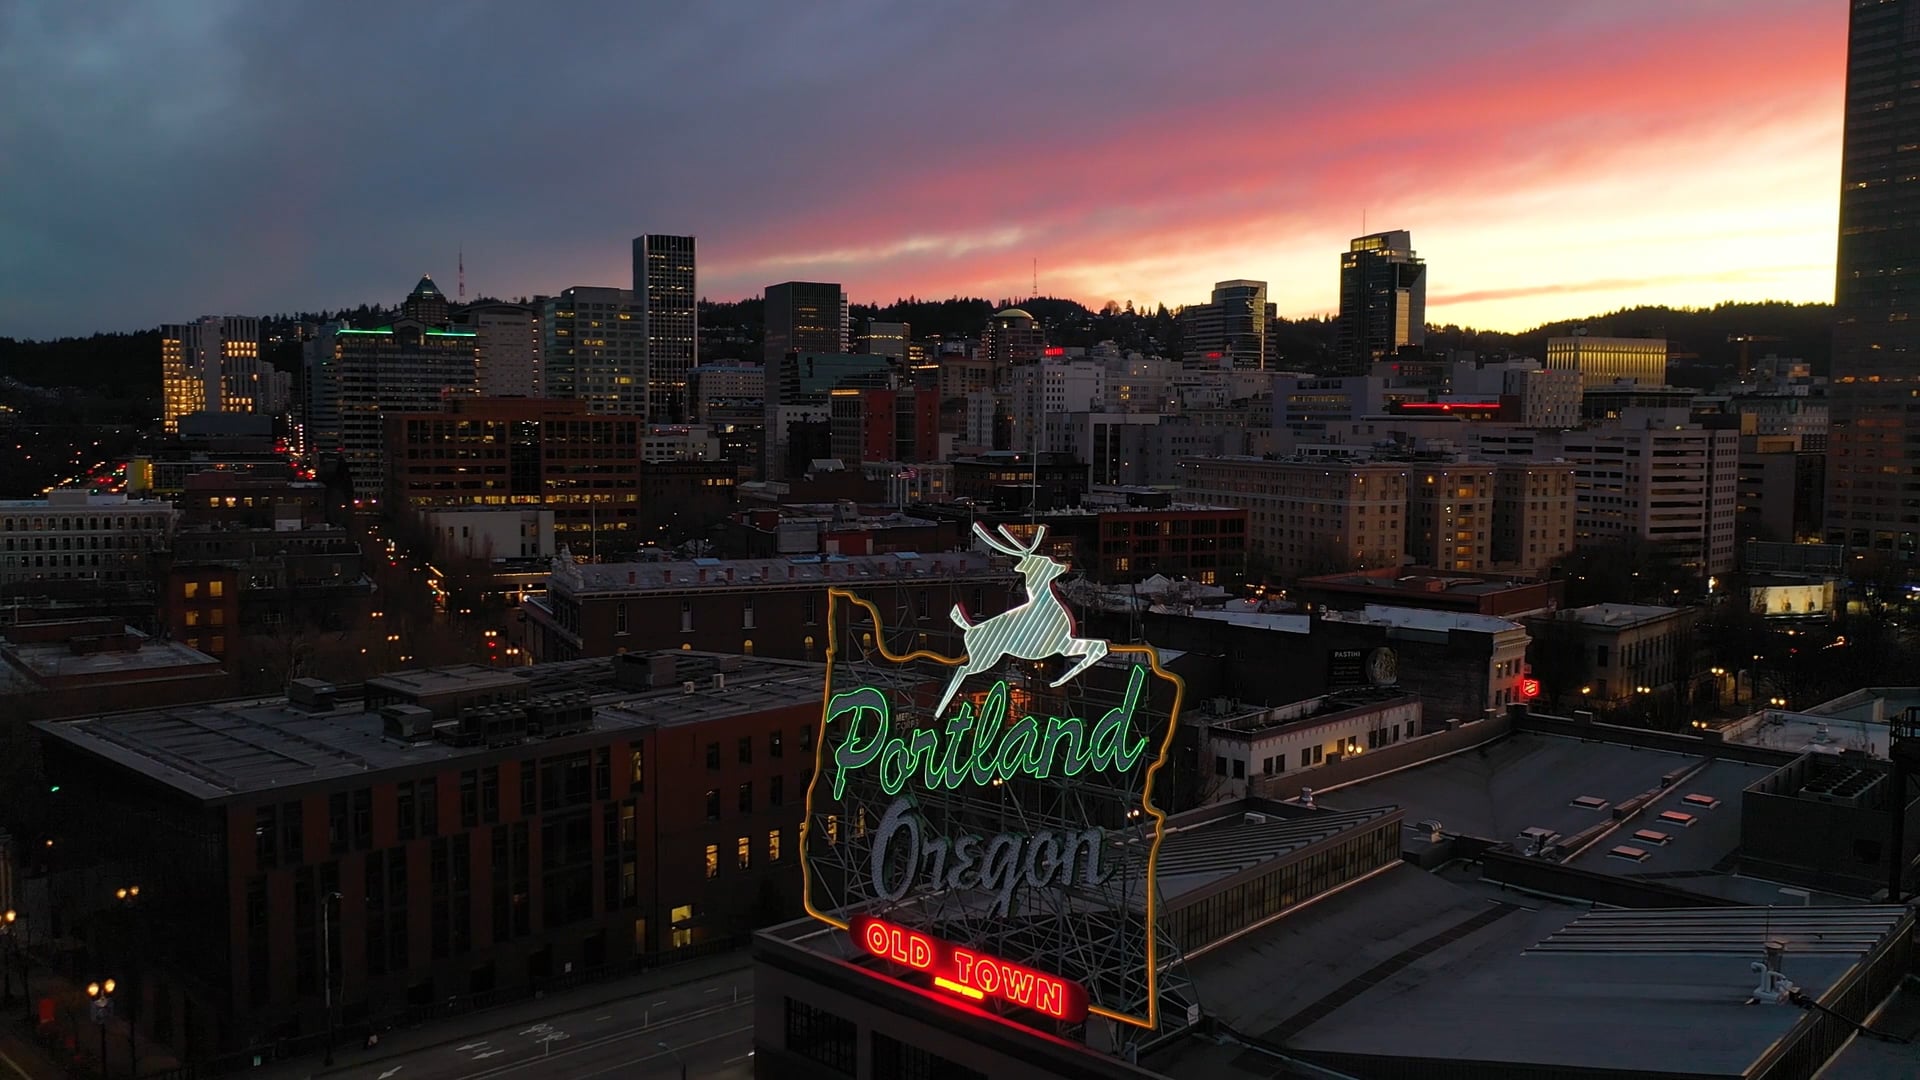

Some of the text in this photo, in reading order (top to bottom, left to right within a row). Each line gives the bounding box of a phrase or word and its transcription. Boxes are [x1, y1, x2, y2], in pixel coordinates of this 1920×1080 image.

[826, 663, 1148, 800] Portland
[869, 792, 1113, 917] Oregon
[866, 922, 1063, 1016] OLD TOWN
